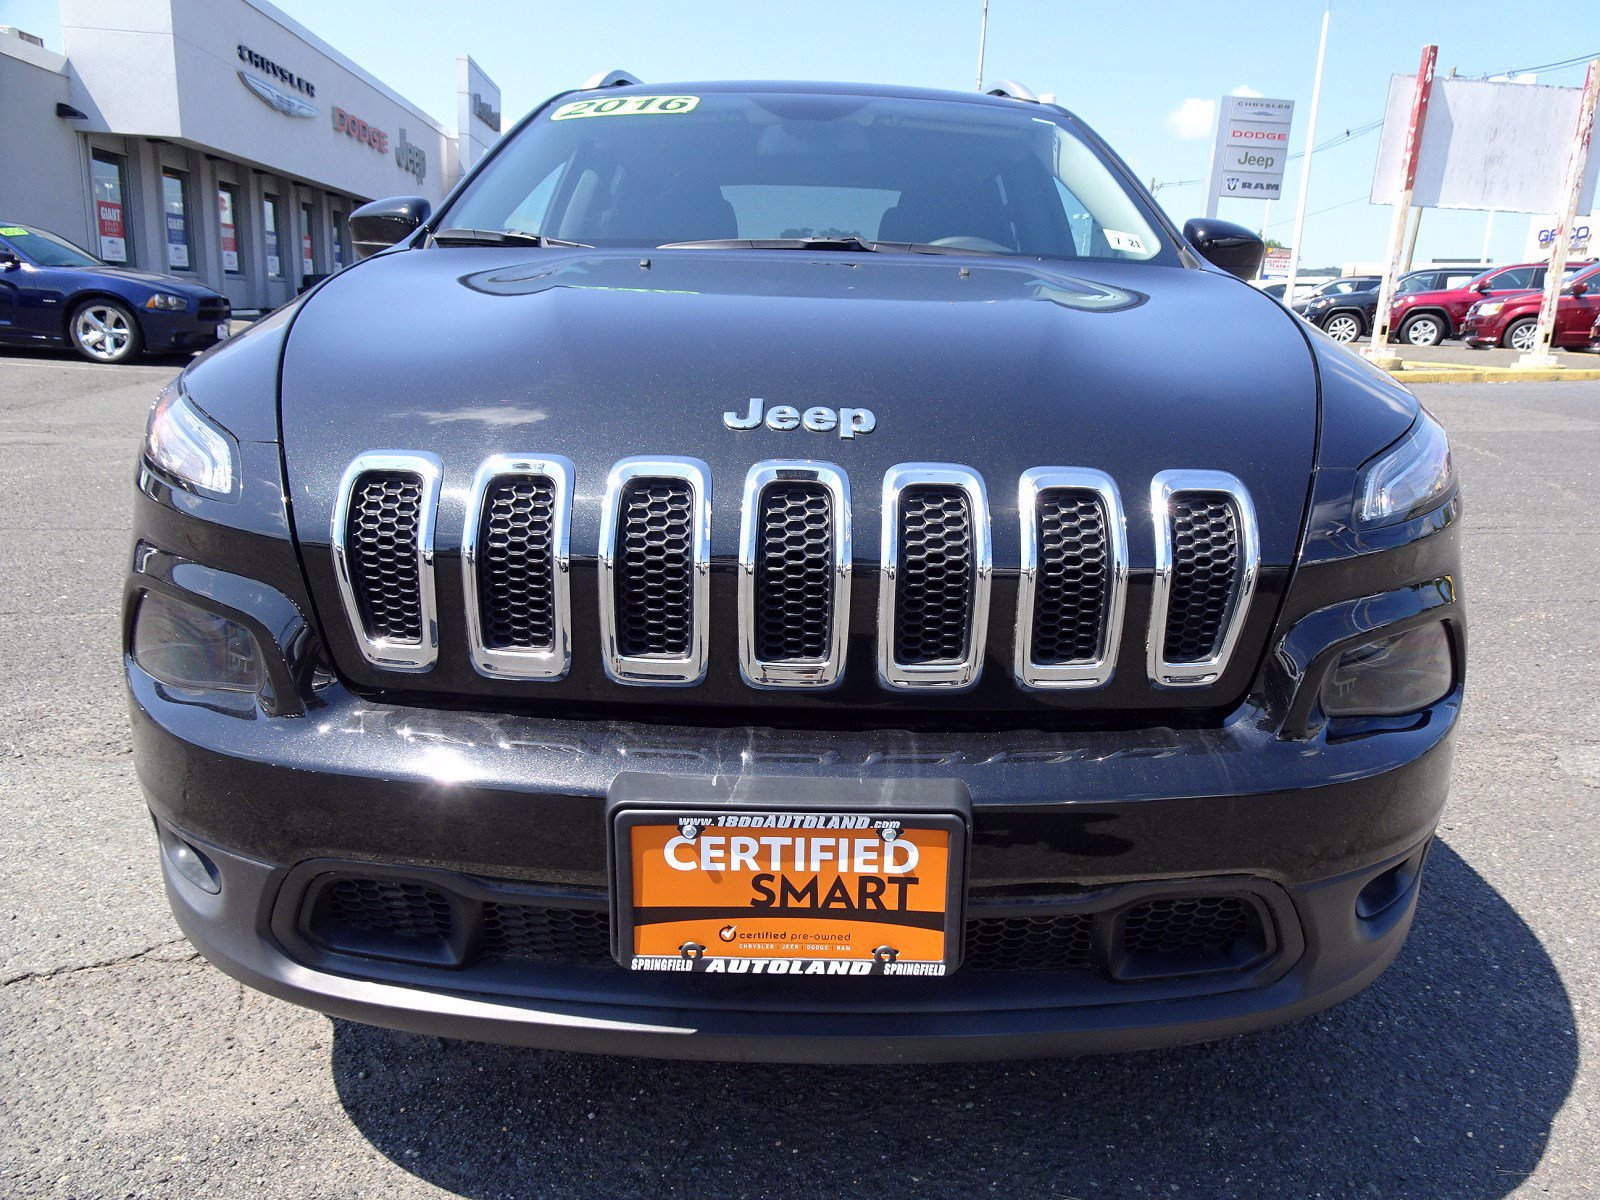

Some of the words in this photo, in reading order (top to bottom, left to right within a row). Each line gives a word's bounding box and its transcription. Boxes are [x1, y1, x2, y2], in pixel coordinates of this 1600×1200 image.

[238, 44, 315, 97] CHRYSLER
[559, 97, 690, 117] 2016
[1237, 101, 1290, 110] CHRYSLER
[332, 107, 388, 154] DODGE
[1232, 130, 1287, 142] DODGE
[395, 127, 427, 186] Jeep
[1237, 152, 1275, 170] Jeep
[1241, 181, 1280, 191] RAM
[100, 206, 121, 222] GIANT
[1538, 226, 1588, 241] GEO
[1128, 239, 1141, 248] 21
[723, 397, 877, 440] Jeep
[663, 835, 919, 874] CERTIFIED
[750, 873, 919, 911] SMART
[739, 931, 787, 940] certified
[790, 932, 851, 942] pre-owned
[631, 958, 694, 972] SPRINGFIELD
[705, 959, 873, 976] AUTOLAND
[883, 962, 946, 976] SPRINGFIELD
